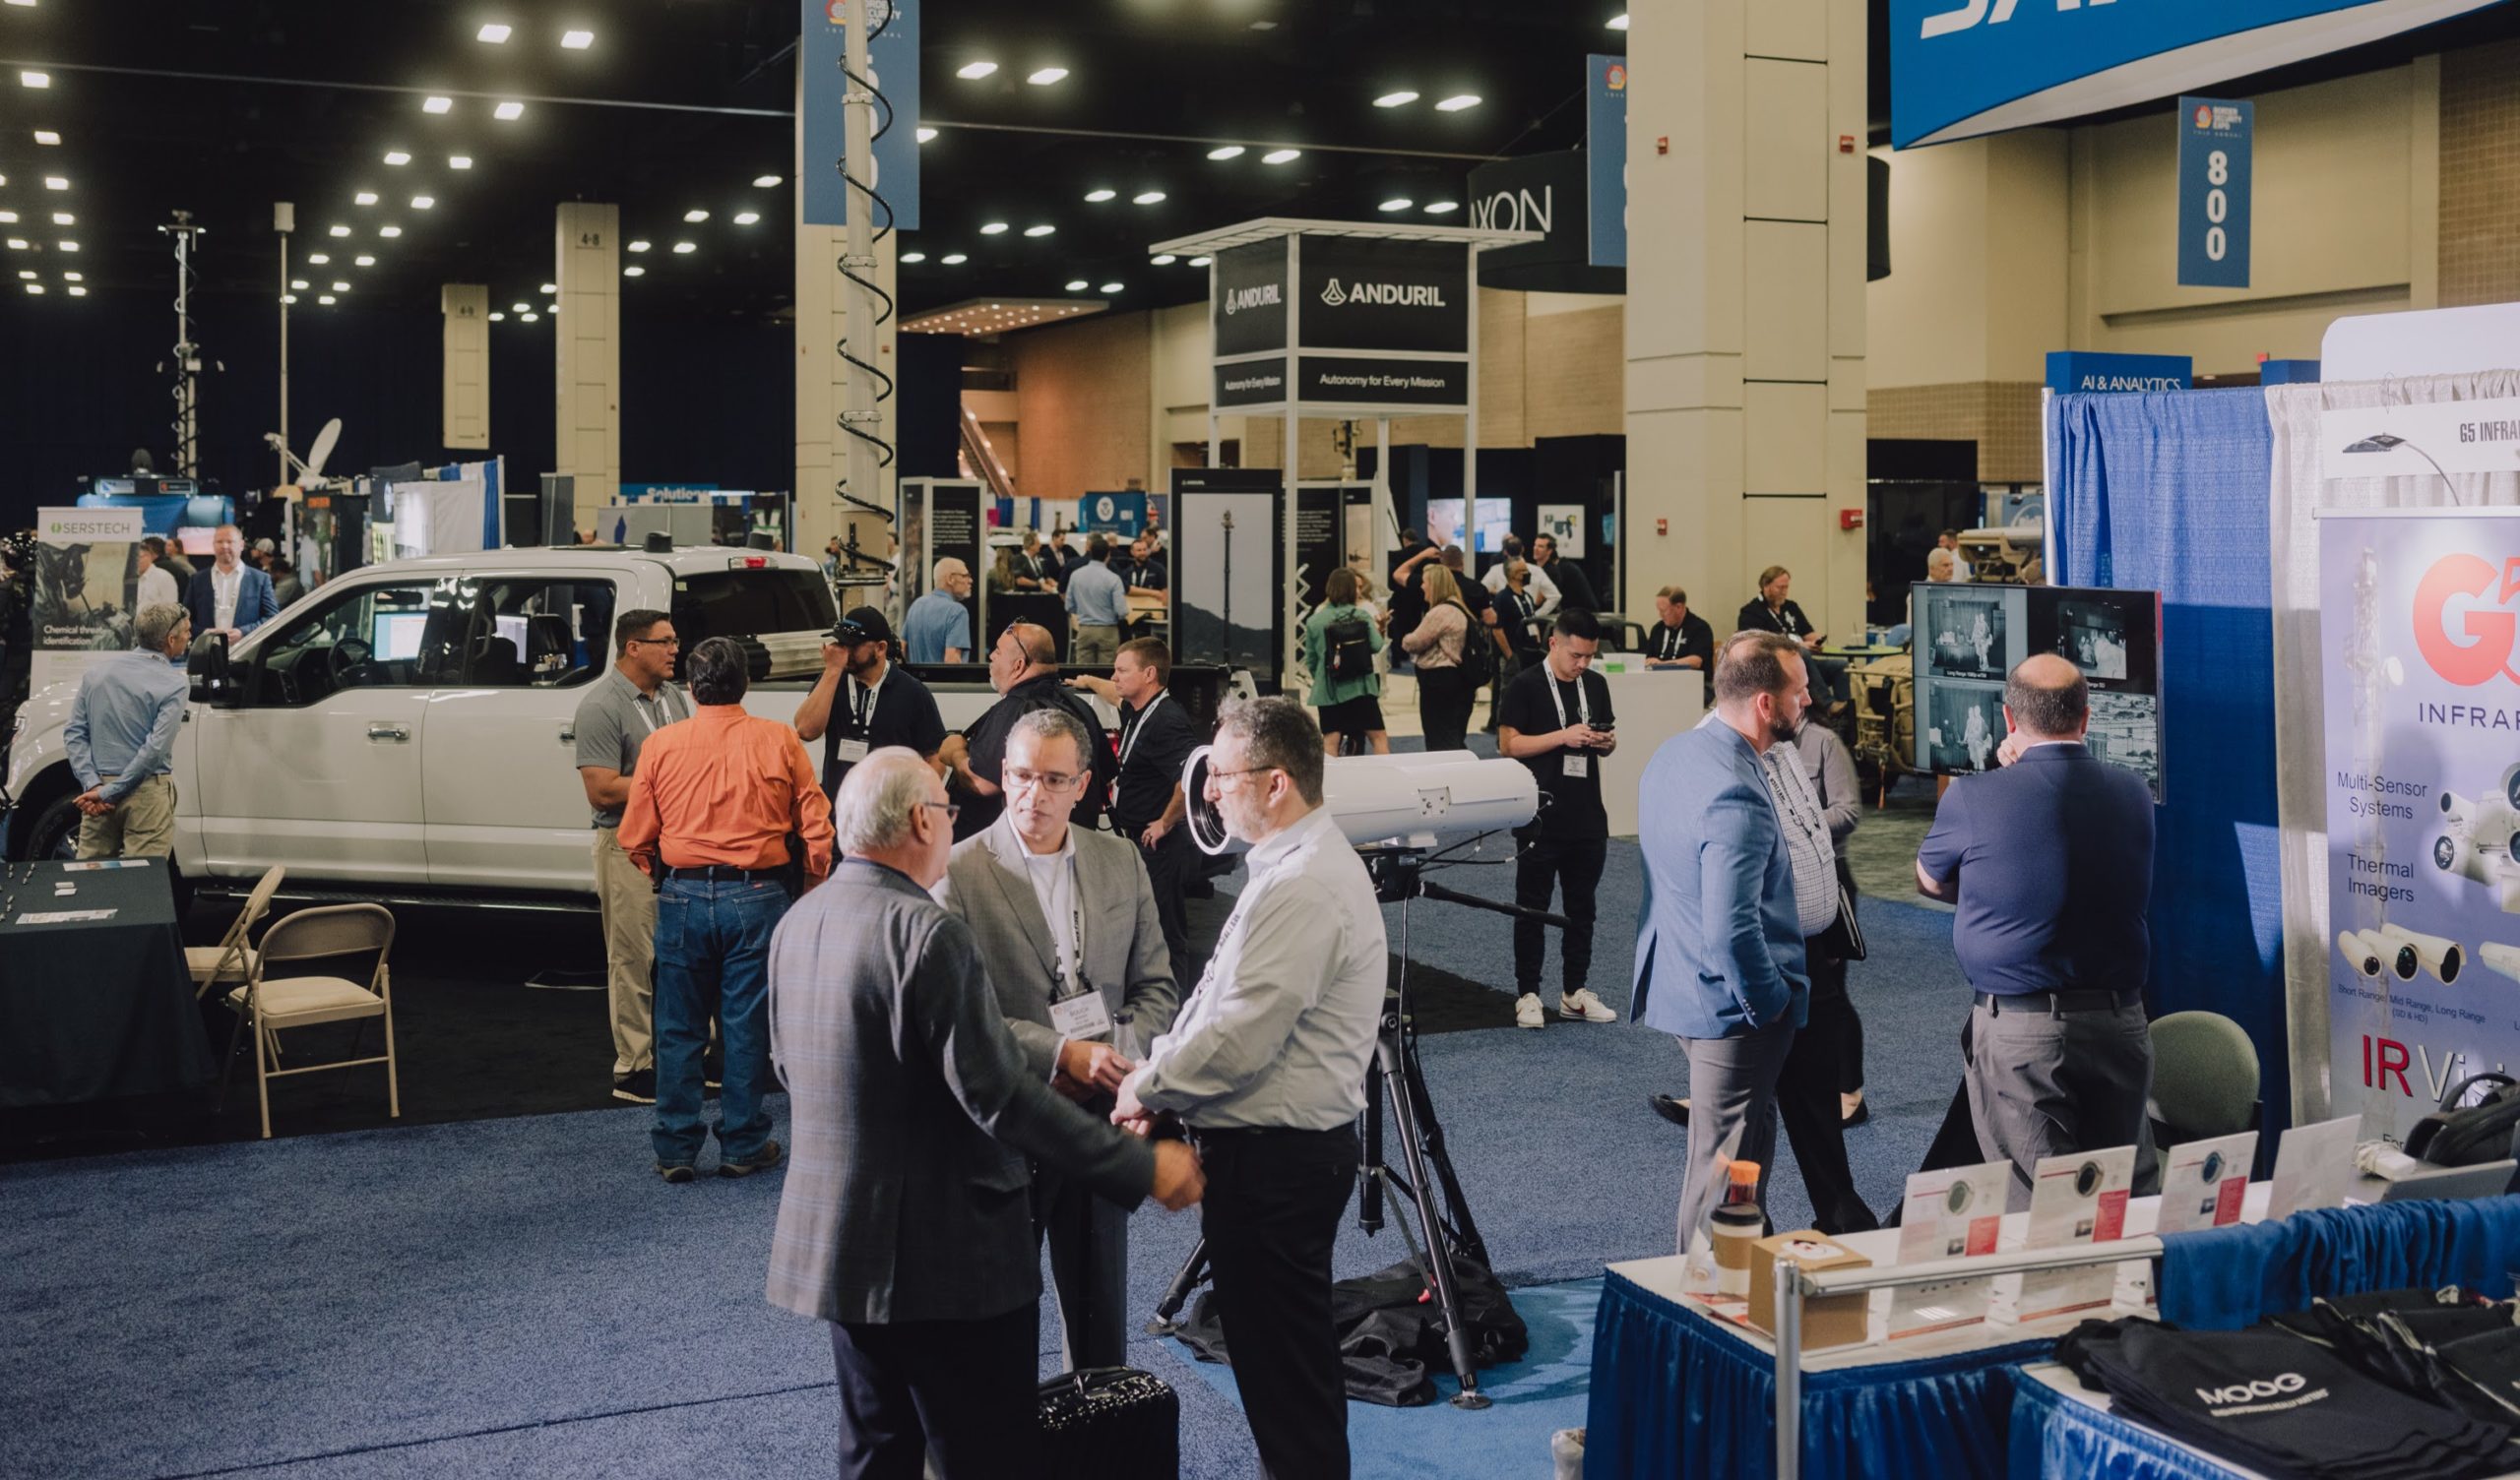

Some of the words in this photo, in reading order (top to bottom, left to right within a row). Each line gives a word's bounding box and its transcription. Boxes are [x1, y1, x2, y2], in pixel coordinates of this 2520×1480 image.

[2206, 150, 2228, 261] 800
[1237, 283, 1282, 310] ANDURIL
[1350, 282, 1446, 307] ANDURIL
[1319, 374, 1368, 388] Autonomy
[1369, 375, 1382, 386] for
[1383, 376, 1410, 389] Every
[1411, 377, 1445, 388] Mission
[2081, 375, 2095, 390] AI
[2097, 376, 2108, 391] &
[2110, 376, 2181, 392] ANALYTICS
[2460, 423, 2476, 443] G5
[2480, 419, 2520, 441] INFRA
[647, 486, 701, 500] Solutio
[63, 523, 130, 534] SERSTECH
[2420, 702, 2520, 731] INFRA
[2338, 771, 2427, 797] Multi-Sensor
[2350, 796, 2413, 819] Systems
[2347, 853, 2414, 879] Thermal
[2348, 877, 2415, 902] Imagers
[2338, 984, 2357, 996] Short
[2389, 994, 2404, 1005] Mid
[2435, 1004, 2457, 1018] Long
[2459, 1009, 2487, 1024] Range
[2195, 1373, 2306, 1404] MOOG
